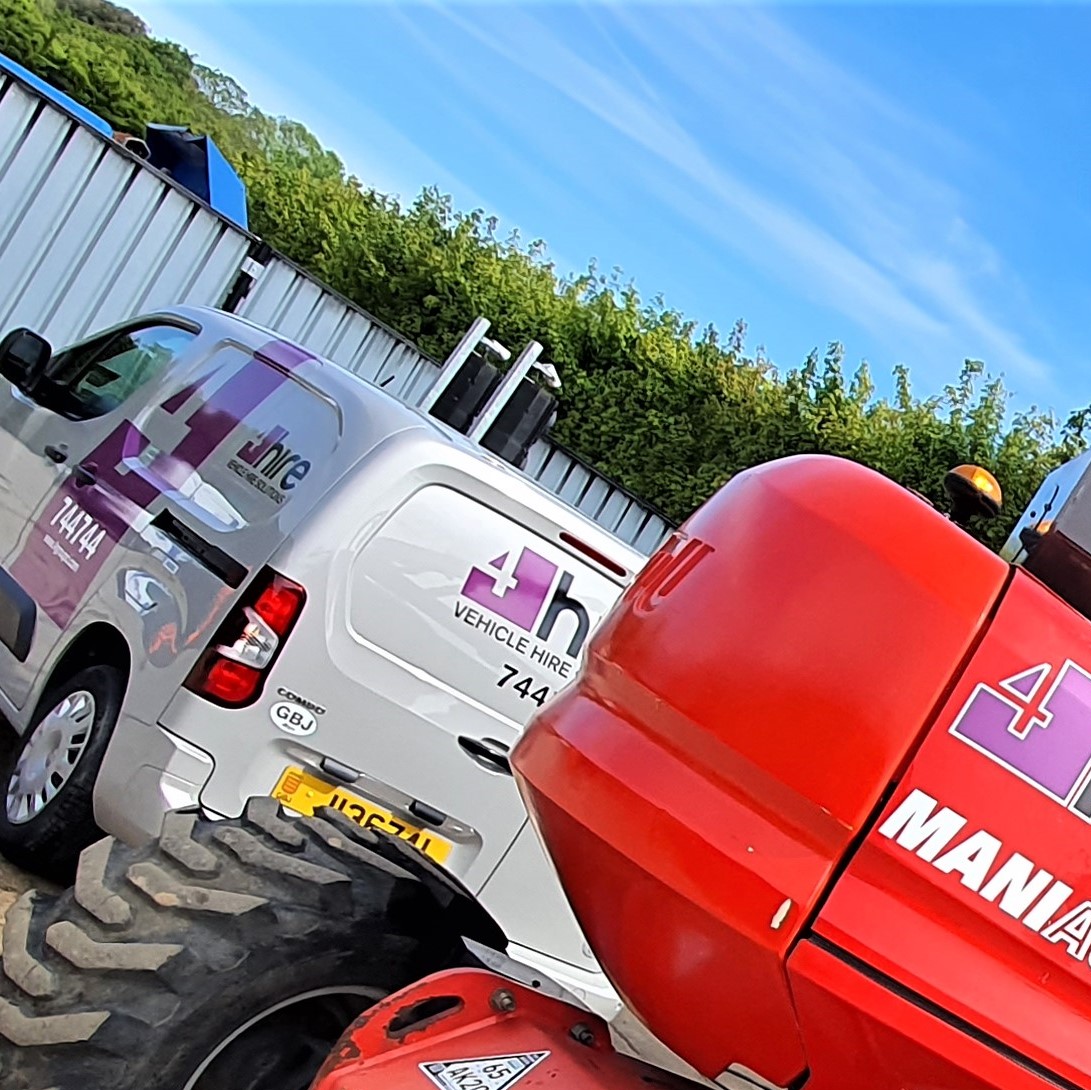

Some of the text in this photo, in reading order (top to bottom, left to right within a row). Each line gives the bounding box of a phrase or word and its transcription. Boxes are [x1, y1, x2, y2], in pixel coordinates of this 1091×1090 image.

[50, 496, 107, 560] 744744
[461, 546, 590, 659] 4h
[454, 601, 572, 678] VEHICLE HIRE
[497, 664, 553, 707] 744
[277, 706, 313, 731] GBJ
[482, 1064, 511, 1079] 65
